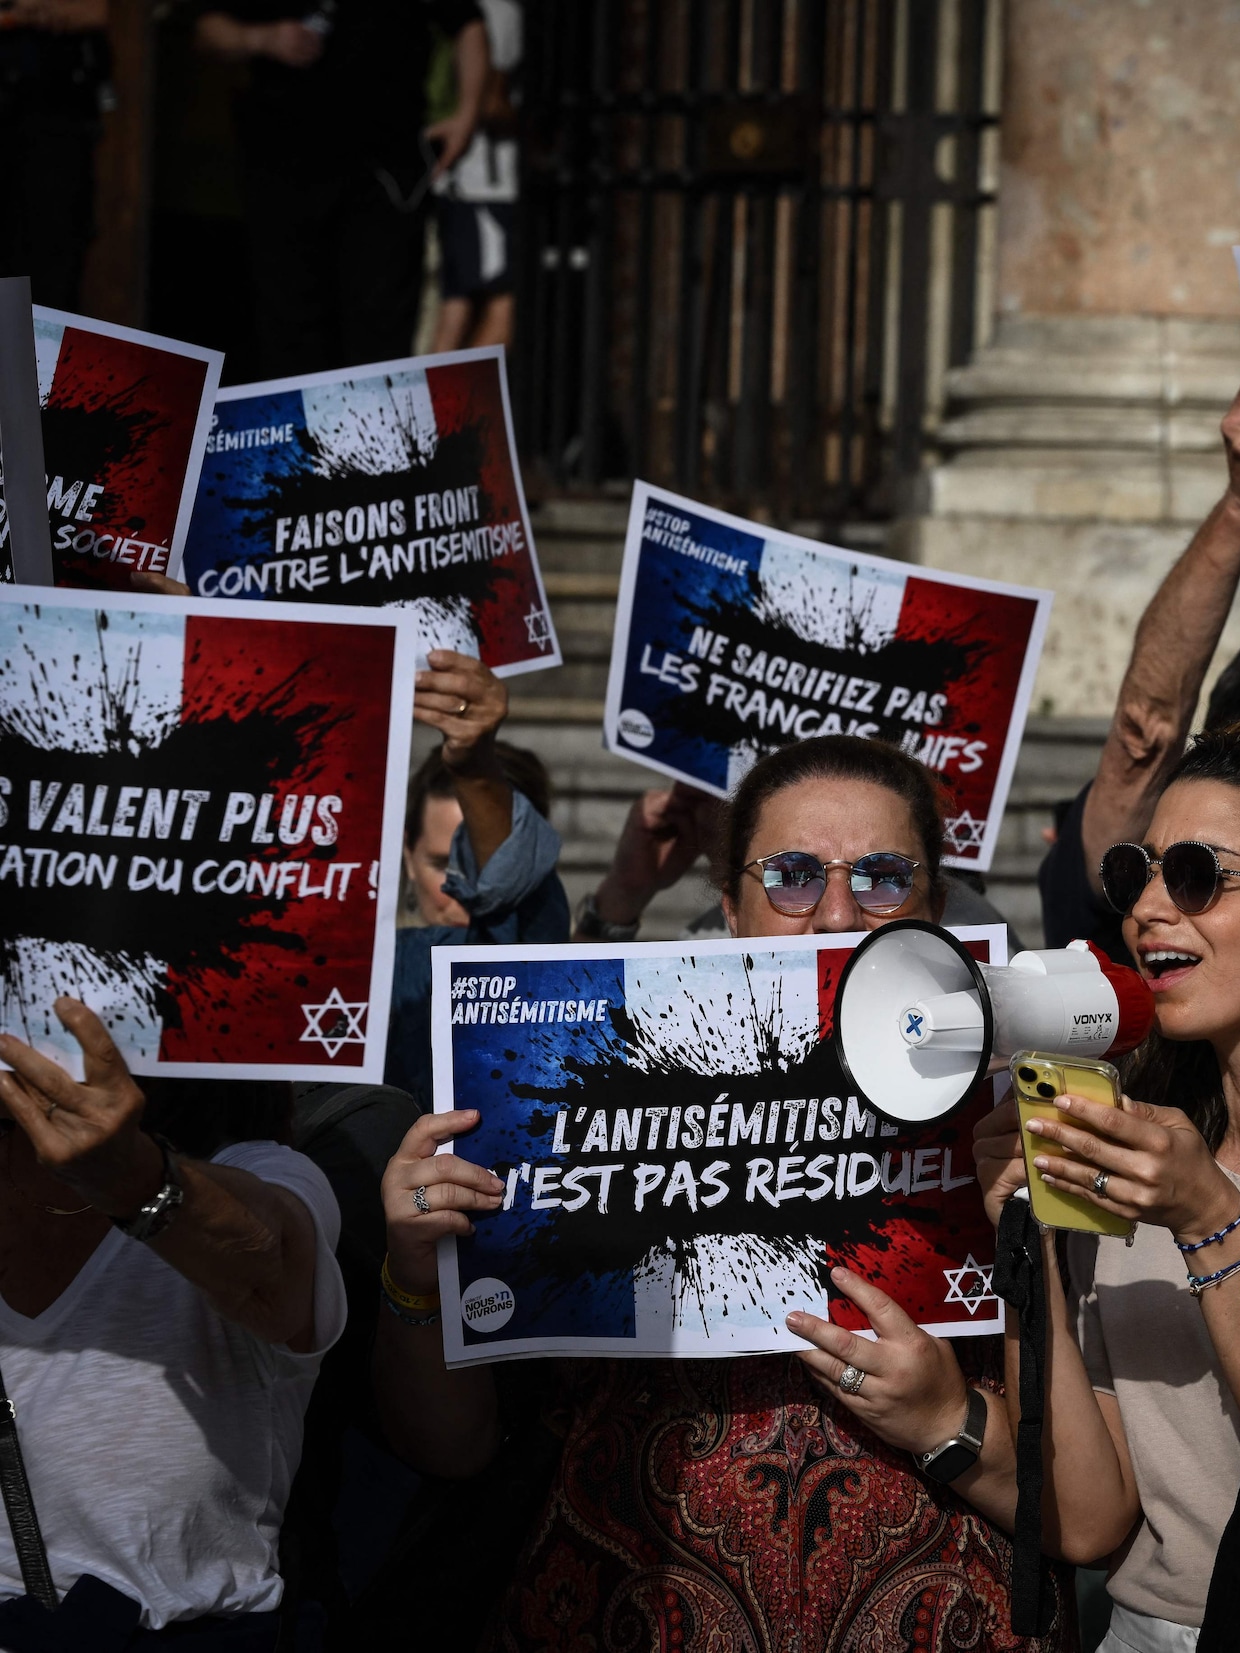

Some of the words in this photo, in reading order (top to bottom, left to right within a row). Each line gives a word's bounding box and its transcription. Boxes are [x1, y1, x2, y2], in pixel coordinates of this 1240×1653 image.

[275, 499, 407, 553] FAISONS
[414, 485, 480, 531] FRONT
[646, 507, 691, 535] #STOP
[53, 524, 170, 572] SOCIÉTÉ
[642, 524, 750, 577] ANTISÉMITISME
[198, 555, 331, 598] CONTRE
[639, 643, 702, 693] LES
[687, 626, 730, 666] NE
[731, 643, 882, 713] SACRIFIEZ
[883, 686, 948, 725] PAS
[28, 780, 210, 841] VALENT
[218, 791, 343, 847] PLUS
[0, 844, 119, 890] ATION
[128, 855, 184, 896] DU
[192, 859, 362, 902] CONFLIT
[450, 996, 608, 1025] ANTISÉMITISME
[451, 976, 517, 999] #STOP
[1073, 1012, 1112, 1025] VONYX
[634, 1160, 731, 1214] PAS
[745, 1140, 976, 1208] RÉSIDUEL
[465, 1297, 495, 1313] NOUS
[466, 1301, 513, 1321] VIVRONS
